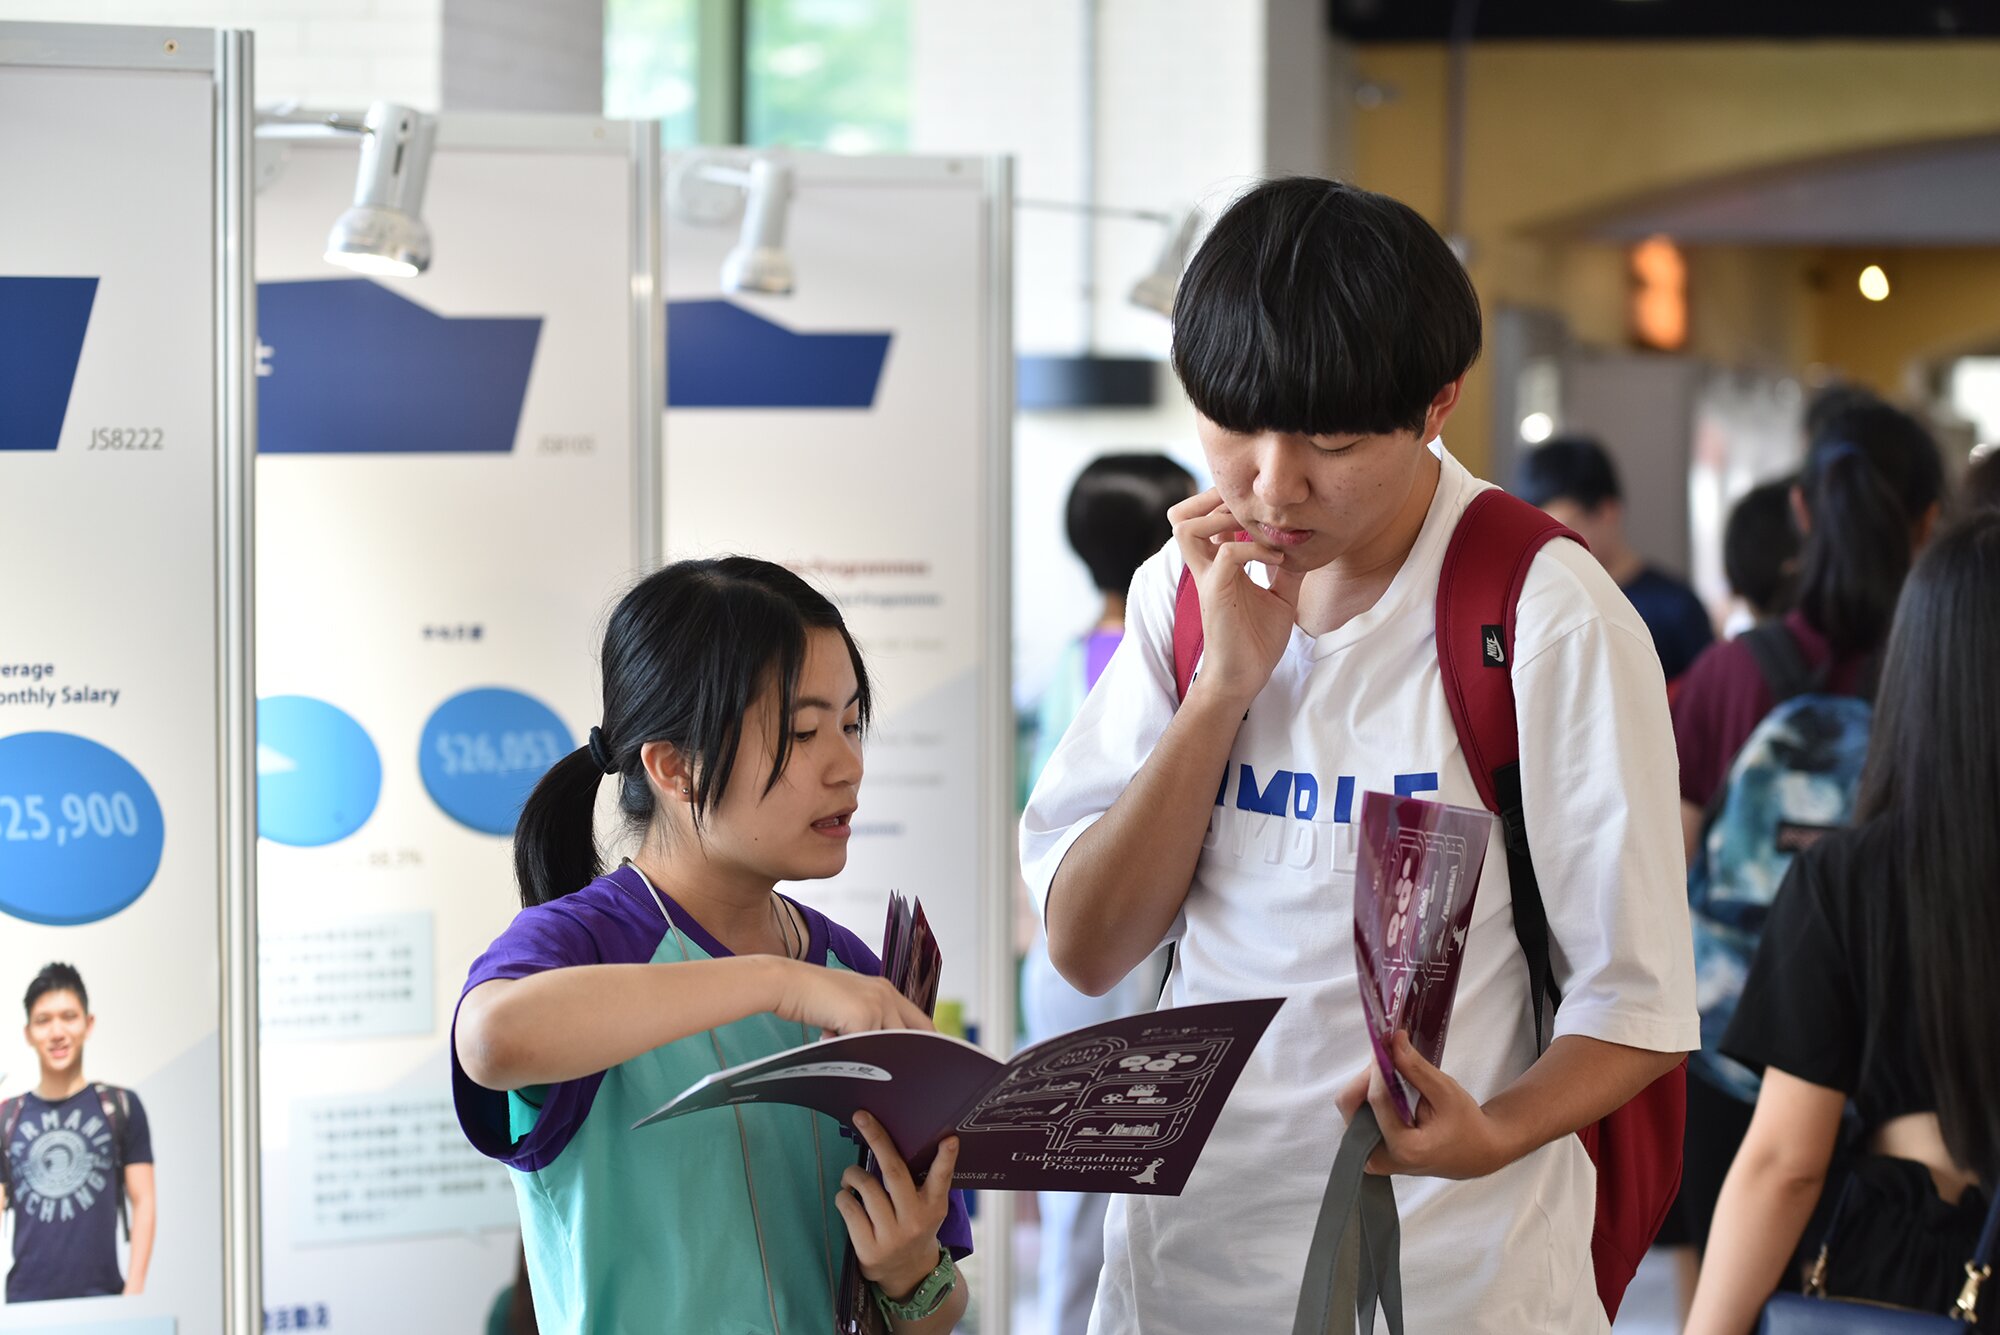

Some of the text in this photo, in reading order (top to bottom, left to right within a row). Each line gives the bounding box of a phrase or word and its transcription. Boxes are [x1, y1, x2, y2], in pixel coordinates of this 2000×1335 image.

[87, 427, 163, 451] JS8222
[1486, 636, 1499, 658] NIKE
[0, 663, 54, 681] erage
[0, 685, 120, 709] onthly Salary
[0, 790, 139, 847] 25,900
[1011, 1152, 1144, 1165] Undergraduate
[1042, 1161, 1139, 1173] Prospectus
